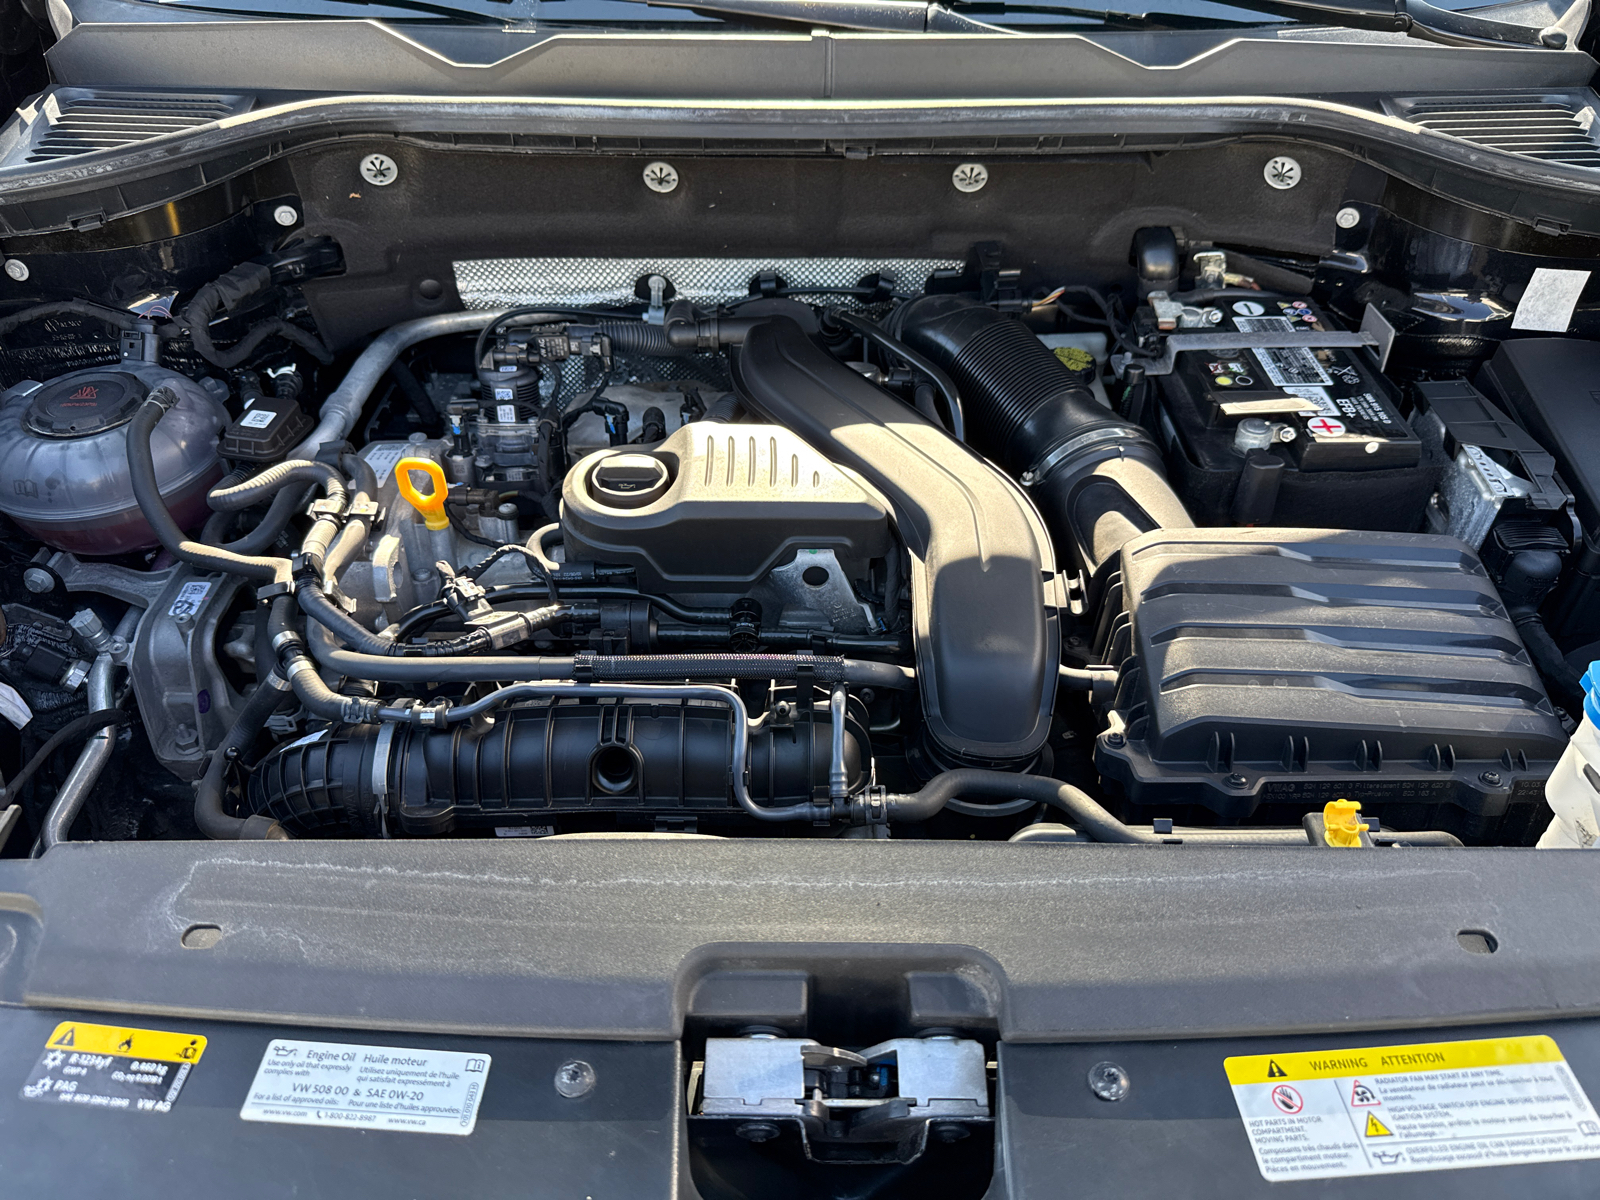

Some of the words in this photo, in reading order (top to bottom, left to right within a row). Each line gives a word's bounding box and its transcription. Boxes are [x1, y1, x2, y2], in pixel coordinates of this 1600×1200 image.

[1336, 399, 1356, 419] EFB+
[306, 1050, 339, 1062] Engine
[341, 1052, 357, 1061] Oil
[363, 1054, 389, 1064] Huile
[391, 1057, 427, 1066] moteur
[1309, 1057, 1368, 1072] WARNING
[1381, 1052, 1445, 1067] ATTENTION
[68, 1053, 114, 1069] R-1234yf
[156, 1064, 169, 1076] kg
[281, 1060, 295, 1069] only
[296, 1060, 305, 1068] oil
[306, 1061, 320, 1069] that
[321, 1063, 351, 1072] expressly
[264, 1068, 293, 1076] complies
[360, 1066, 384, 1075] Utilisez
[386, 1069, 427, 1079] uniquement
[439, 1071, 460, 1080] l'huile
[1375, 1077, 1409, 1085] RADIATOR
[1439, 1072, 1460, 1080] START
[1470, 1070, 1484, 1078] ANY
[53, 1080, 78, 1092] PAG
[357, 1075, 368, 1083] qui
[369, 1075, 396, 1084] satisfait
[397, 1078, 445, 1087] expressément
[293, 1082, 311, 1093] VW
[312, 1084, 333, 1094] 508
[334, 1086, 349, 1096] 00
[353, 1088, 361, 1097] &
[366, 1088, 388, 1098] SAE
[388, 1089, 424, 1101] 0W-20
[1389, 1084, 1425, 1093] ventilateur
[1437, 1082, 1468, 1090] radiateur
[292, 1096, 323, 1105] approved
[325, 1098, 339, 1106] oils:
[1382, 1094, 1416, 1102] moment.
[137, 1099, 154, 1110] VW
[155, 1100, 171, 1113] AG
[348, 1099, 364, 1107] Pour
[379, 1101, 393, 1109] liste
[394, 1102, 419, 1110] d'huiles
[420, 1105, 461, 1115] approuvées:
[1438, 1101, 1465, 1109] SWITCH
[1465, 1100, 1479, 1108] OFF
[263, 1109, 308, 1117] www.vw.com
[324, 1112, 377, 1121] 1-800-822-8987
[388, 1117, 426, 1125] www.vw.ca
[1296, 1116, 1322, 1124] MOTOR
[1391, 1112, 1423, 1121] IGNITION
[1252, 1125, 1307, 1135] COMPARTMENT.
[1255, 1135, 1283, 1143] MOVING
[1284, 1134, 1310, 1142] PARTS.
[1259, 1145, 1301, 1155] Composants
[1302, 1144, 1316, 1152] très
[1317, 1143, 1341, 1151] chauds
[1342, 1141, 1359, 1149] dans
[1270, 1153, 1321, 1165] compartiment
[1322, 1152, 1352, 1160] moteur.
[1265, 1164, 1289, 1173] Pièces
[1300, 1162, 1347, 1170] mouvement.
